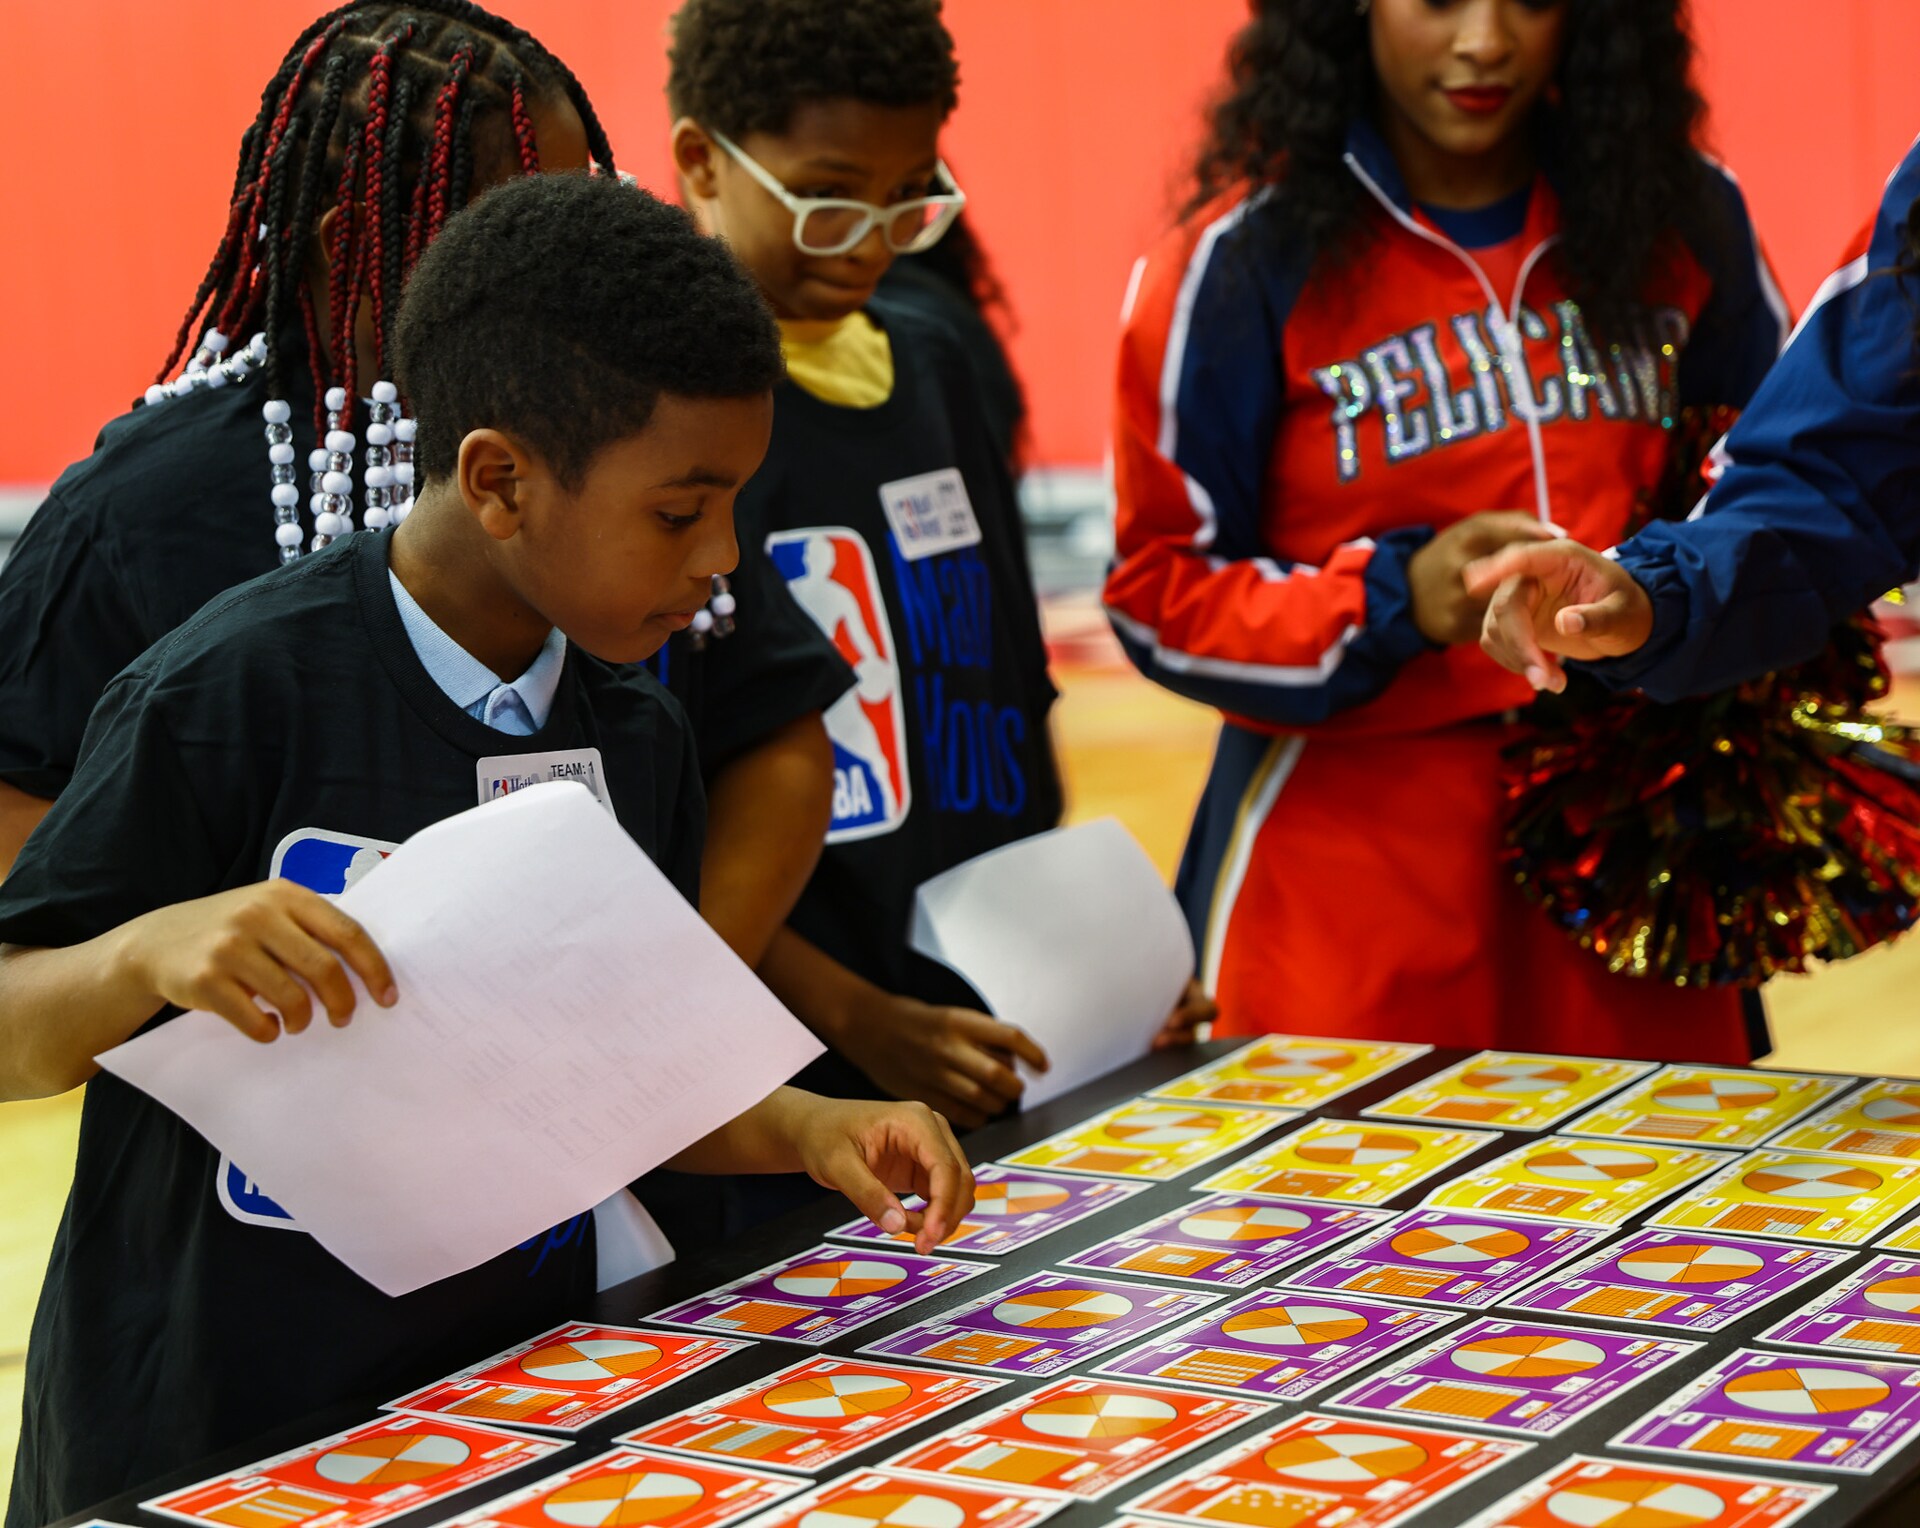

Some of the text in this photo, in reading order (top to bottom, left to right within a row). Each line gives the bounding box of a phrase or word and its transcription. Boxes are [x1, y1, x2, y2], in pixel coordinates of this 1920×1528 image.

[551, 761, 595, 778] TEAM: 1
[832, 765, 873, 818] BA
